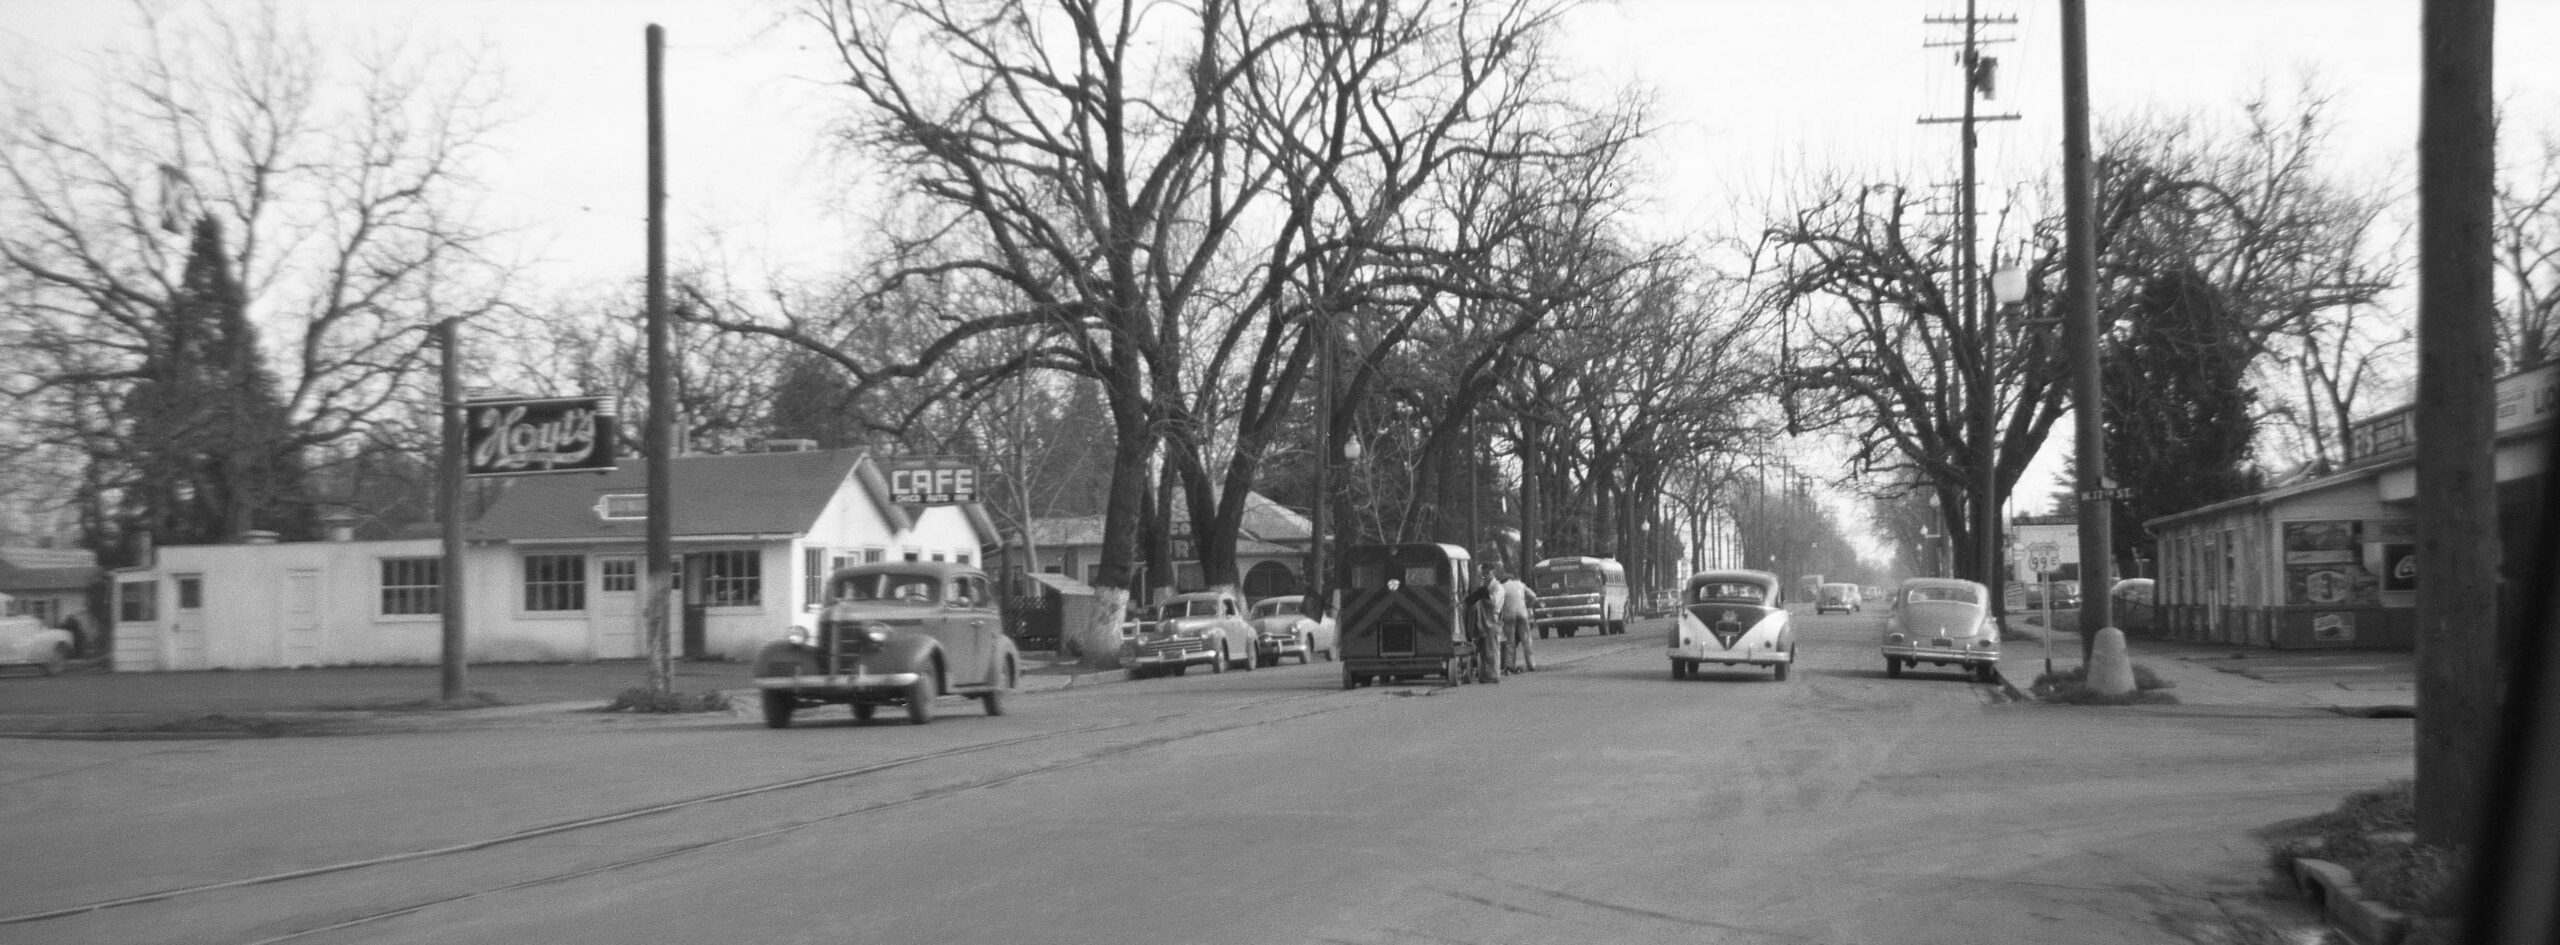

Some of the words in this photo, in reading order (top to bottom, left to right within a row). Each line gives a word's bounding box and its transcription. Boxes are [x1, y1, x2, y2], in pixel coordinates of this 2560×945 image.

[474, 406, 597, 469] Hoyt's
[892, 469, 973, 494] CAFE
[896, 494, 921, 502] CHICO
[926, 494, 949, 502] AUTO
